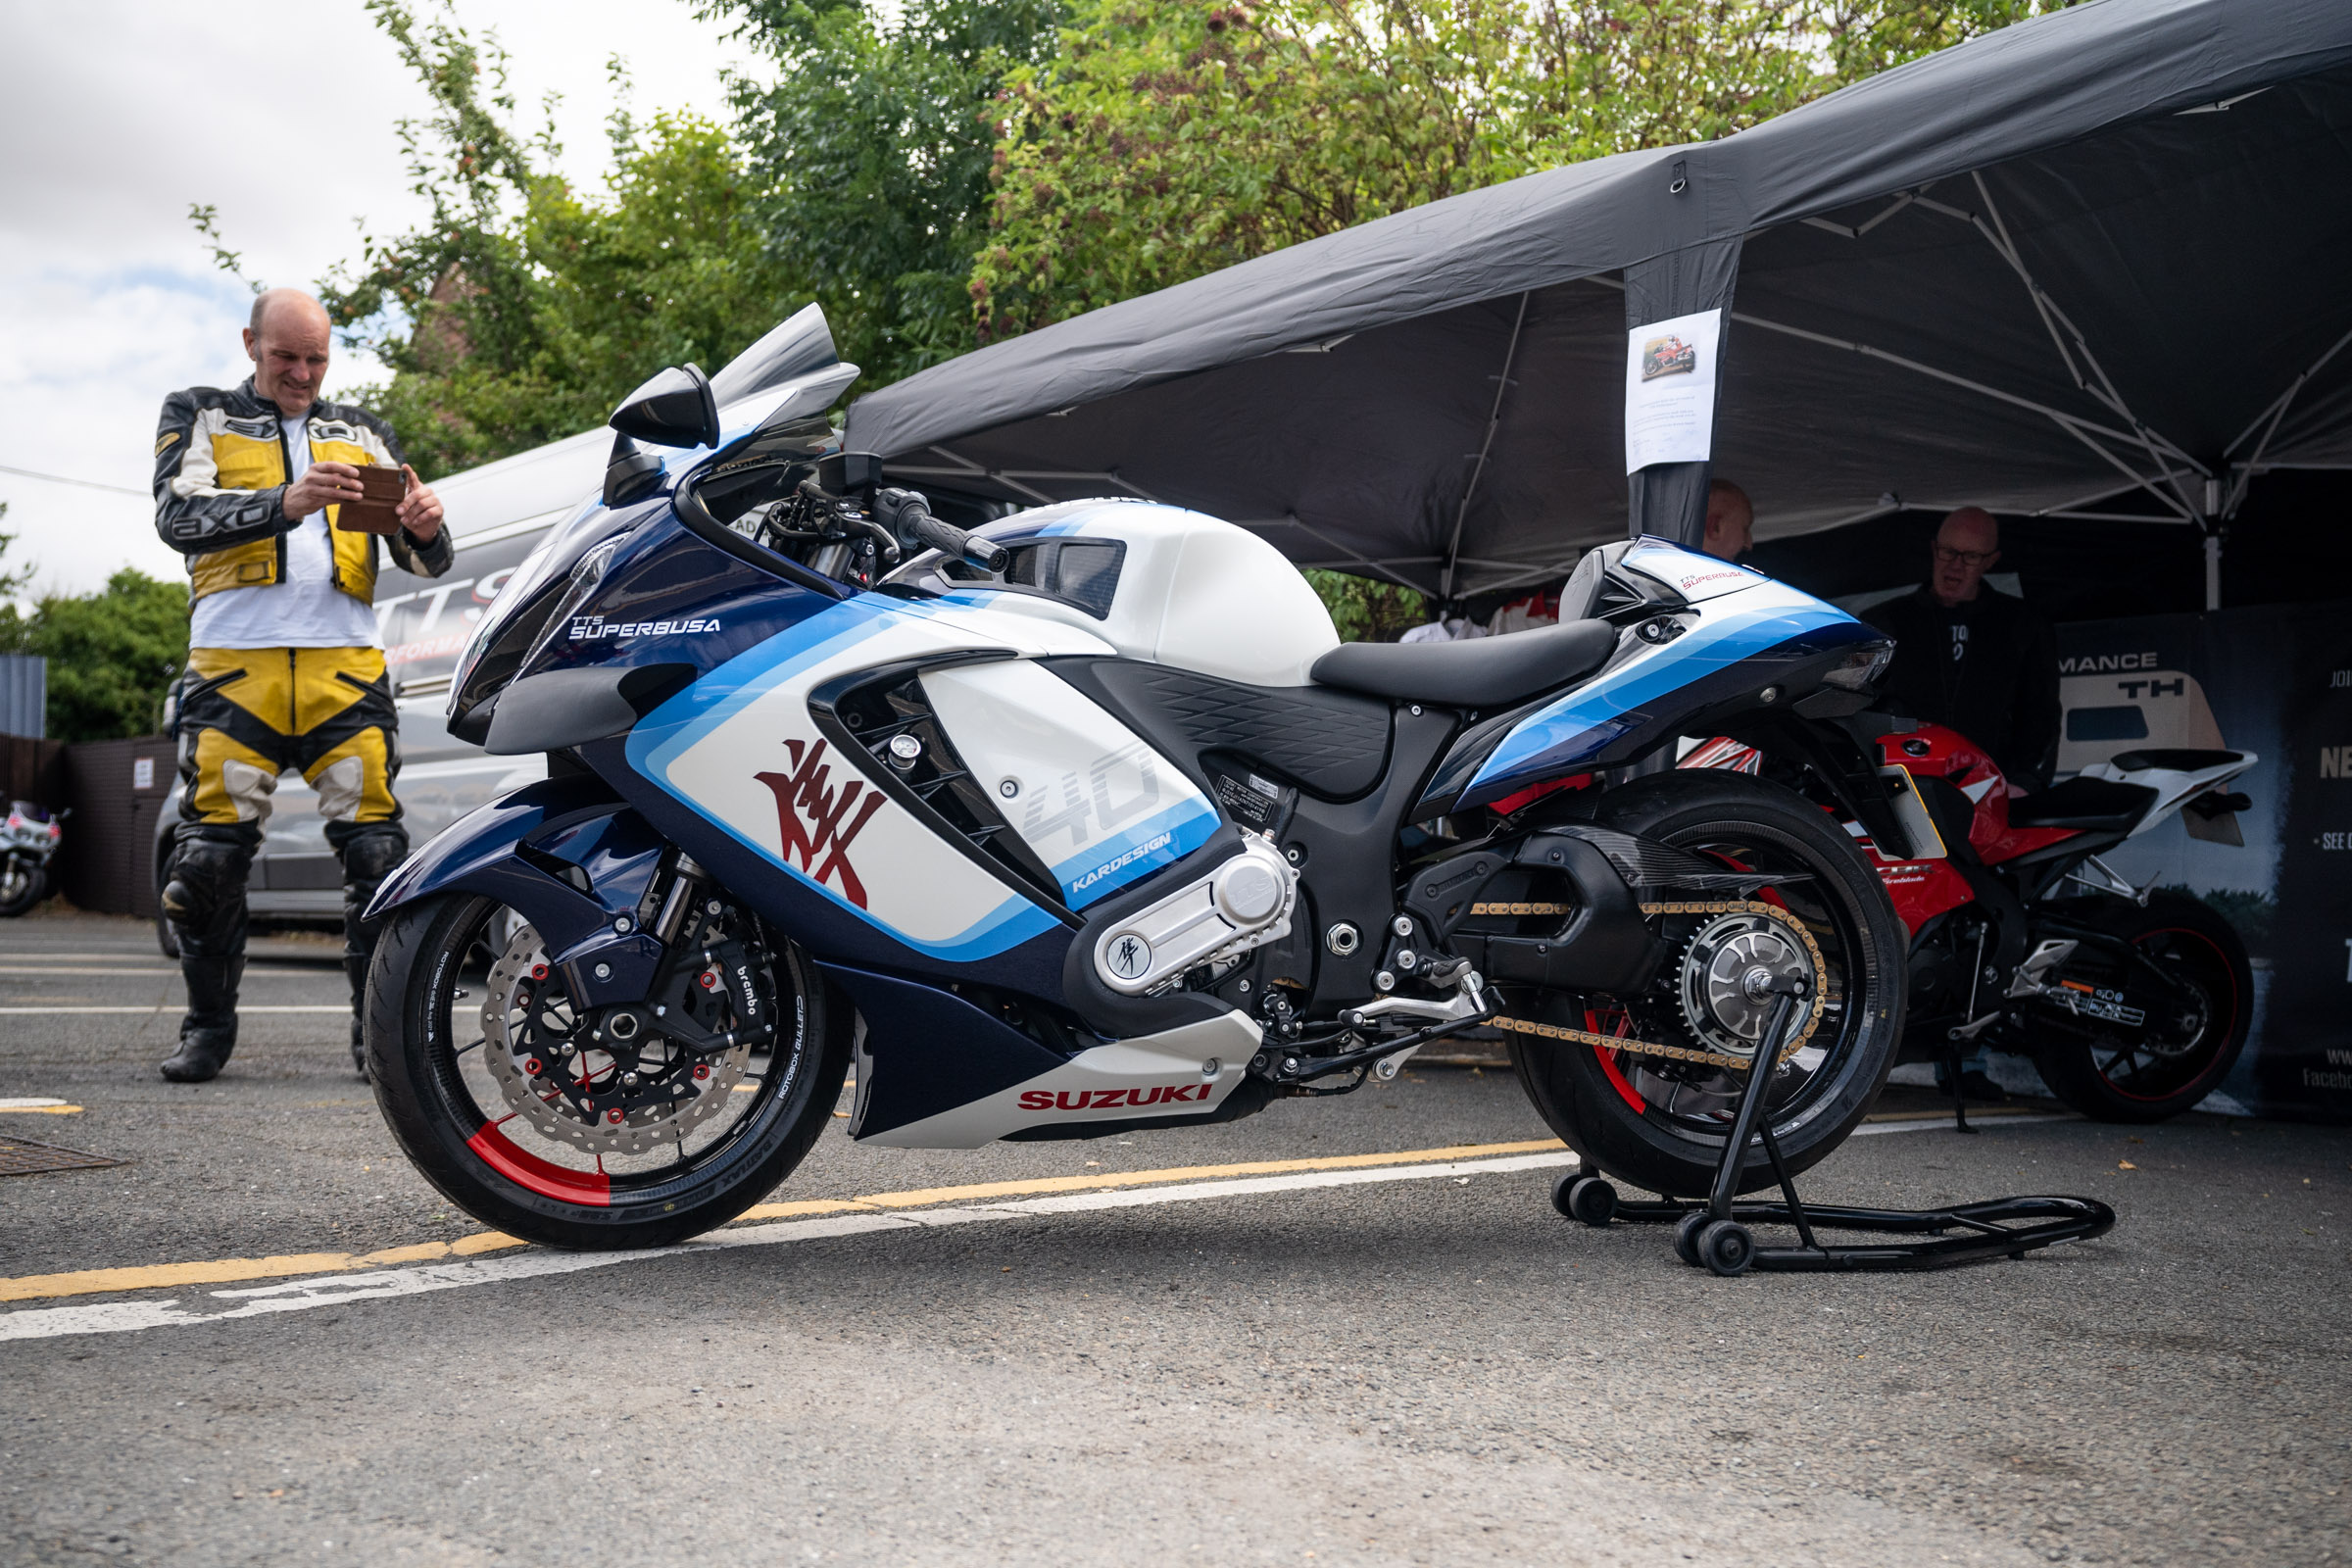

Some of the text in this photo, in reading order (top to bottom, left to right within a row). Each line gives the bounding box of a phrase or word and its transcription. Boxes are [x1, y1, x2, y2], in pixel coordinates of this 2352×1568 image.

[1683, 570, 1744, 591] SUPERBUSA
[568, 619, 721, 640] SUPERBUSA
[572, 615, 605, 626] TTS
[2058, 652, 2158, 673] MANCE
[2329, 669, 2352, 688] JOI
[2323, 832, 2344, 851] SEE
[1072, 832, 1171, 894] KARDESIGN
[432, 951, 449, 990] ROTOBOX
[737, 965, 757, 1016] brembo
[778, 1004, 805, 1101] ROTOBOX BULLET
[1017, 1084, 1213, 1110] SUZUKI
